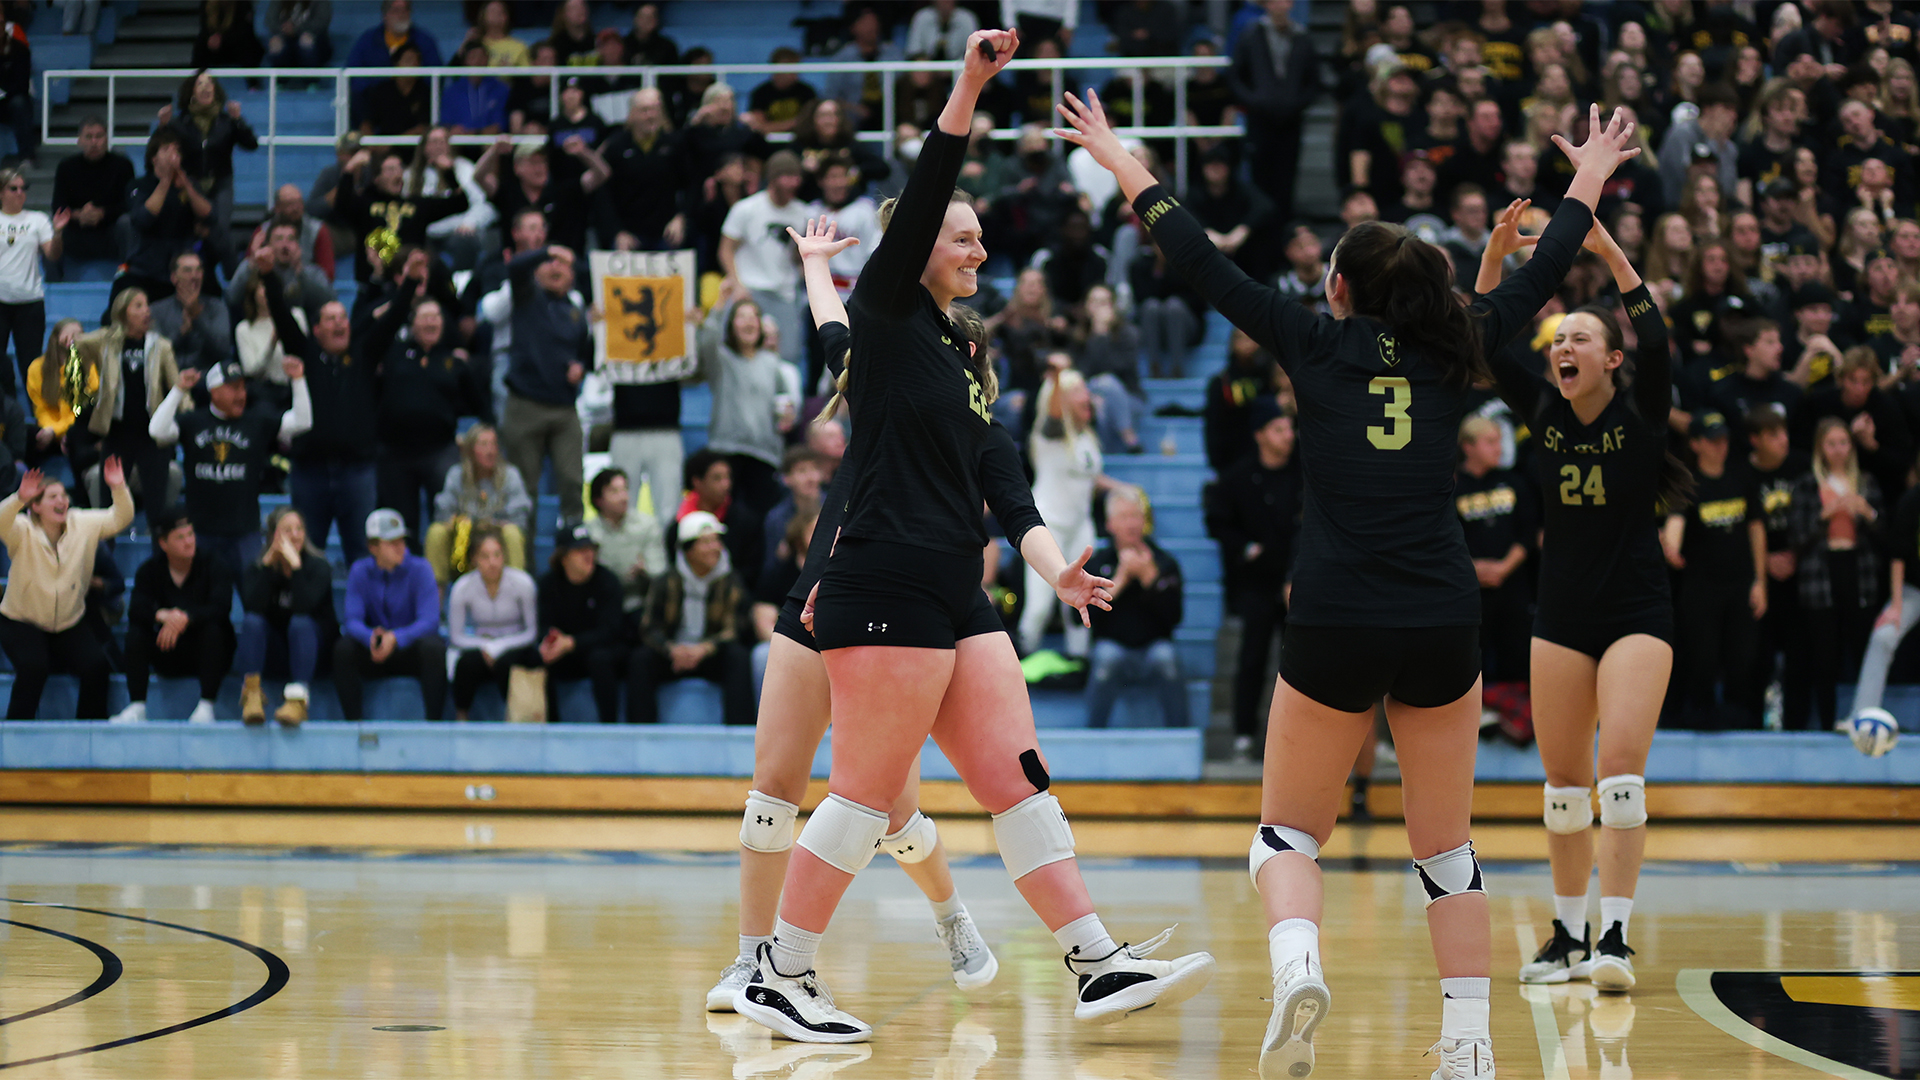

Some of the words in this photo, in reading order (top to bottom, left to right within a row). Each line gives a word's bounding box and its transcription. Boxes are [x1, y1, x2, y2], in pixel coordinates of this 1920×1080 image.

[1143, 199, 1173, 225] YAH!
[1627, 299, 1653, 318] YAH!
[1366, 376, 1412, 450] 3
[1560, 464, 1606, 505] 24
